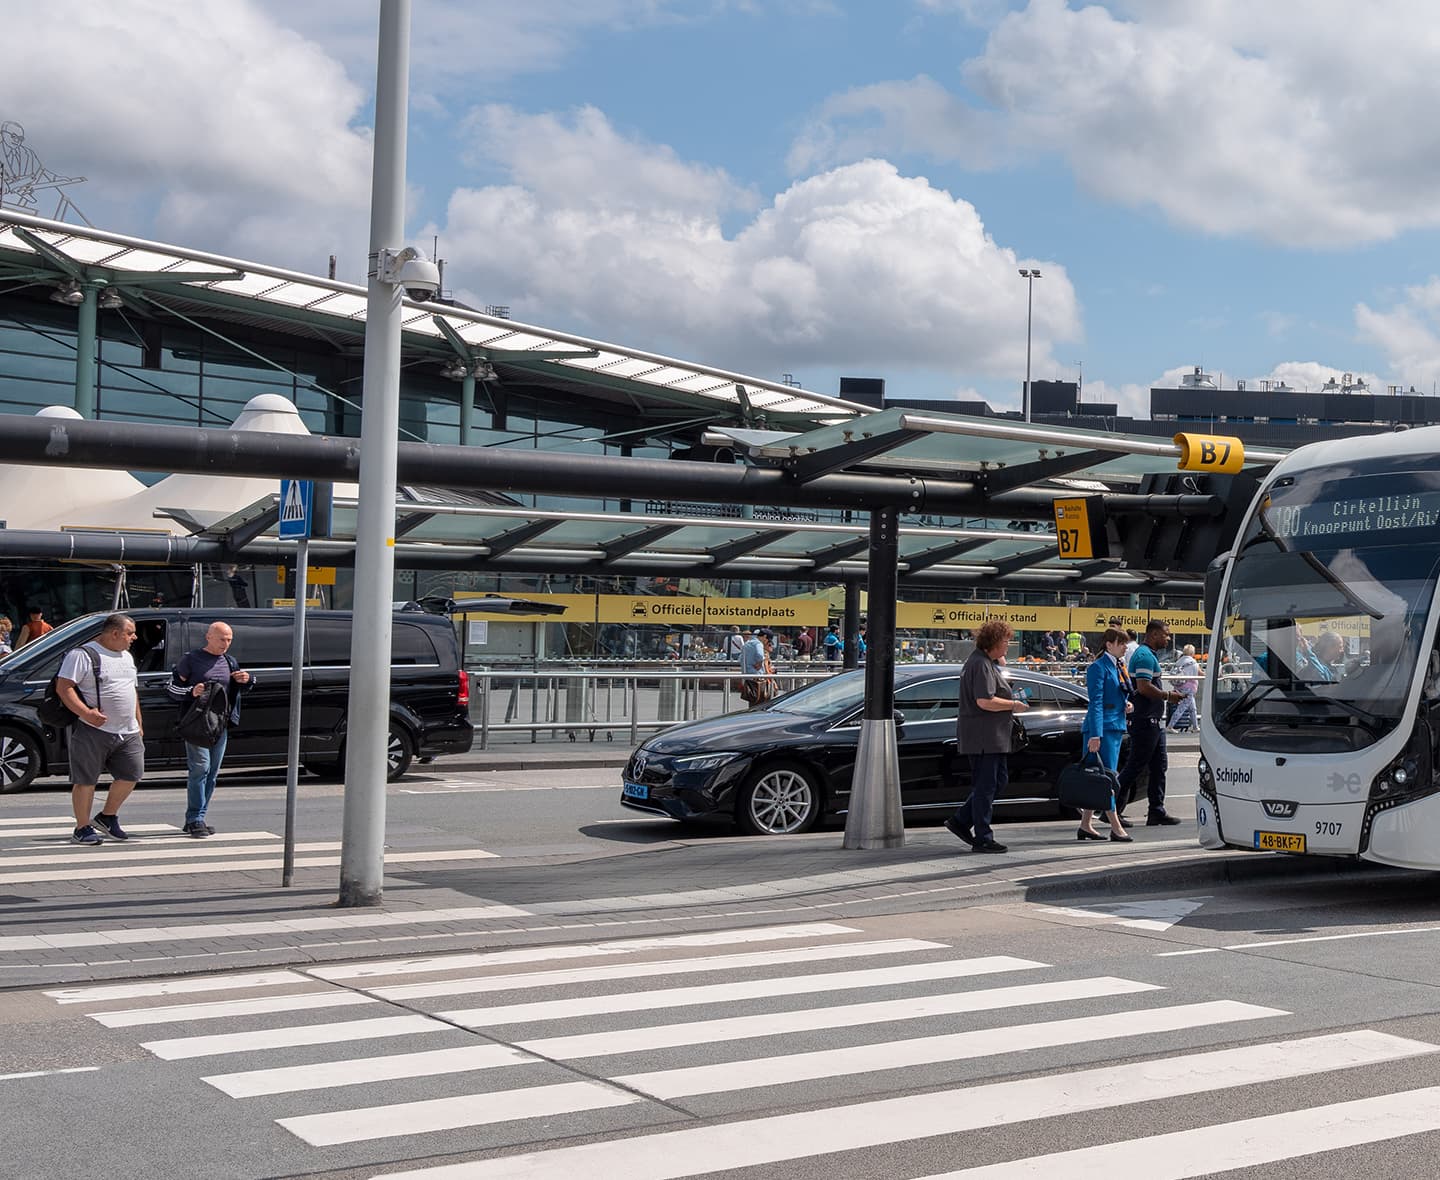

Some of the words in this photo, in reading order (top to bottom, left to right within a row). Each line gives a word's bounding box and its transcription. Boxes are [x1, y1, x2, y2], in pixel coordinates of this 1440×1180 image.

[1200, 441, 1231, 465] B7
[1333, 495, 1421, 516] Cirkellijn
[1276, 507, 1300, 537] 180
[1303, 516, 1371, 536] Knooppunt
[1377, 510, 1439, 529] Oost/Rij
[1060, 529, 1079, 552] B7
[651, 604, 702, 616] Officiële
[707, 605, 795, 618] taxistandplaats
[949, 611, 985, 621] Official
[989, 612, 1008, 621] taxi
[1010, 612, 1037, 623] stand
[1216, 767, 1253, 785] Schiphol
[1266, 803, 1293, 815] VDL
[1315, 821, 1343, 835] 9707
[1262, 835, 1302, 849] 48-BKF-7
